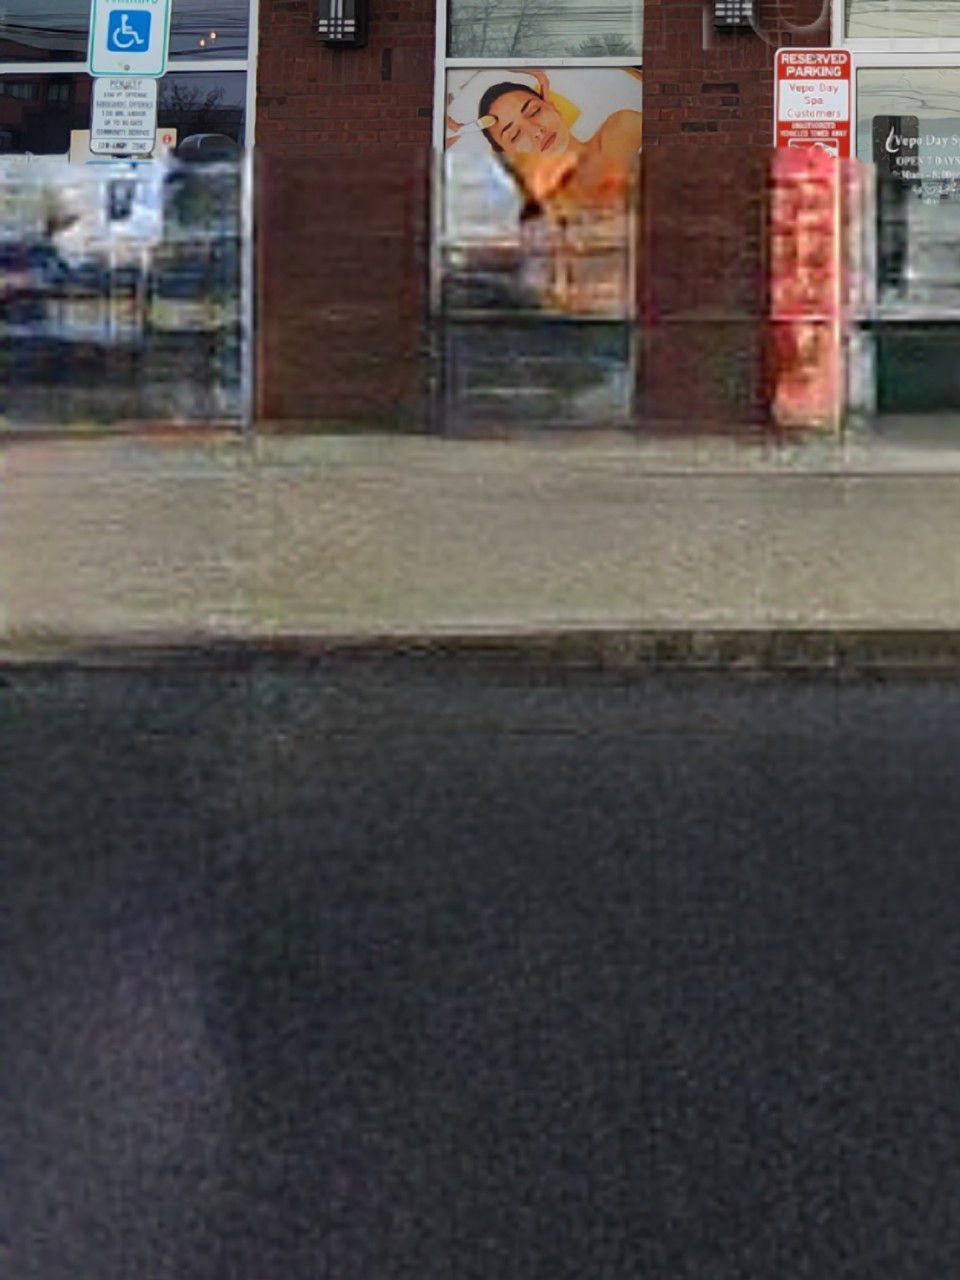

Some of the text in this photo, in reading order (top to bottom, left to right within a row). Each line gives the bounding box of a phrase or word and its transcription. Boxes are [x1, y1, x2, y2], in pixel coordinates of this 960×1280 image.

[780, 53, 848, 65] RESERVED
[785, 66, 842, 77] PARKING
[788, 82, 840, 94] Vepo Day
[804, 95, 824, 106] Spa
[786, 108, 842, 119] Customers
[894, 134, 923, 150] Vepo
[926, 134, 949, 149] Day
[896, 156, 923, 167] OPEN
[935, 156, 960, 166] DAYS
